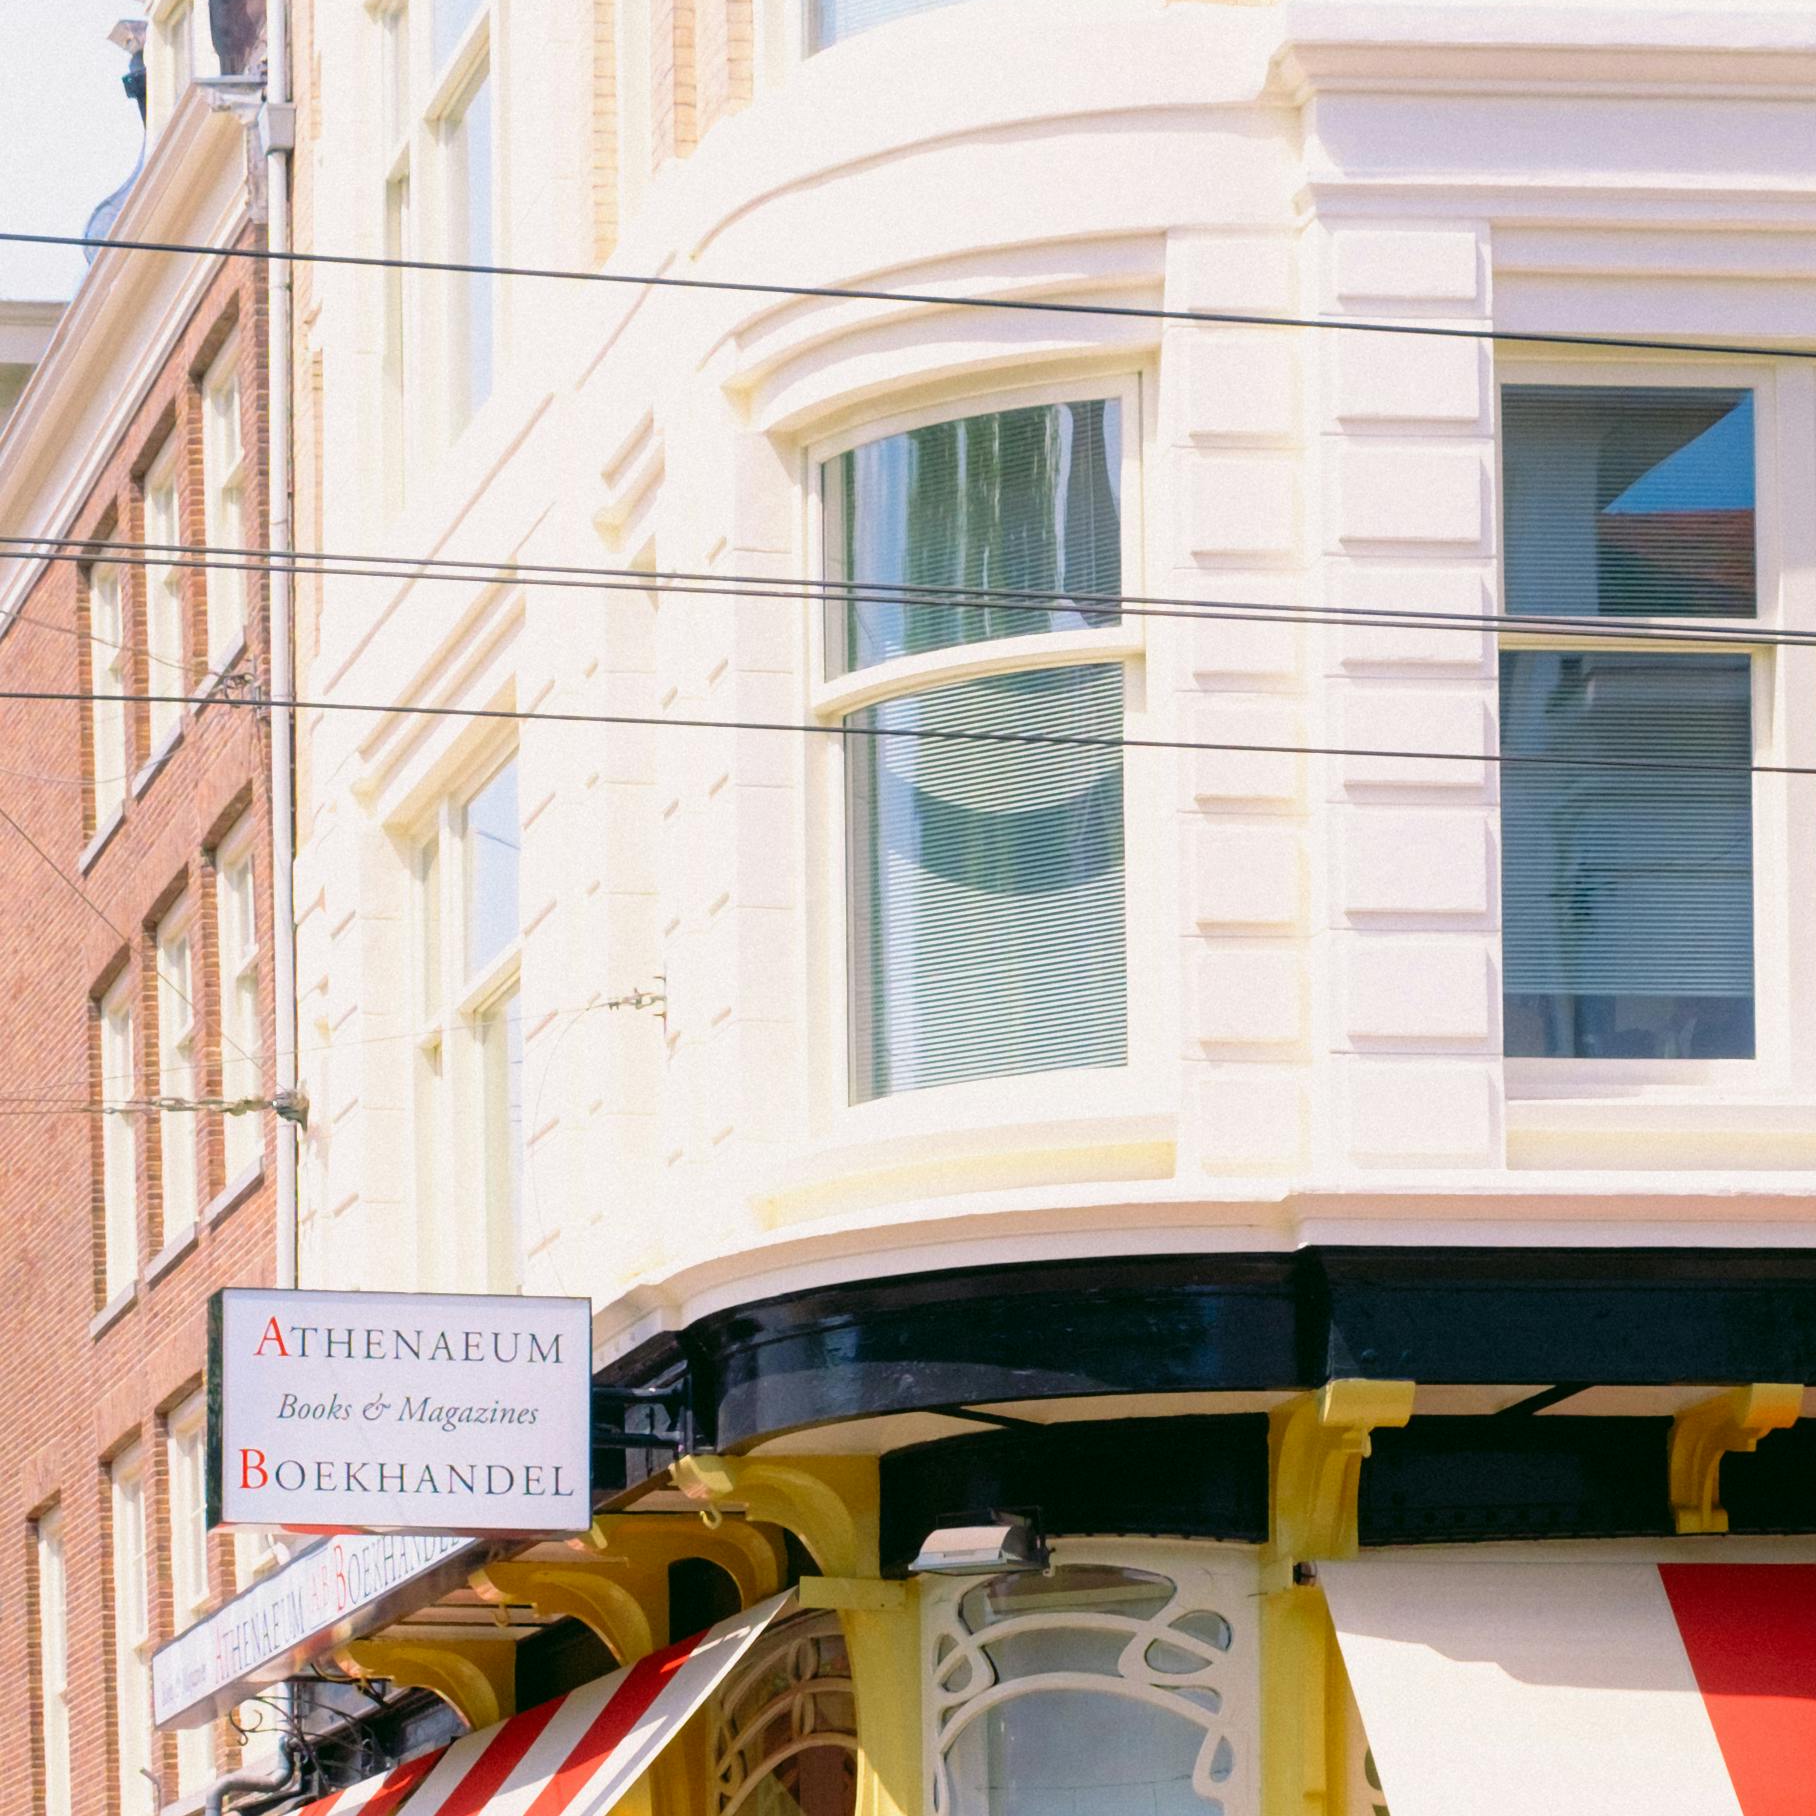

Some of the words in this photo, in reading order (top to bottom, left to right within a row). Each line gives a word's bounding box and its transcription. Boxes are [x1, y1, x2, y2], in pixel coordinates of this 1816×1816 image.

[253, 1315, 564, 1364] ATHENAEUM
[277, 1393, 353, 1421] Books
[362, 1393, 391, 1421] &
[397, 1395, 539, 1432] Magazines
[239, 1448, 575, 1497] BOEKHANDEL
[215, 1587, 305, 1684] ATHENAEUM
